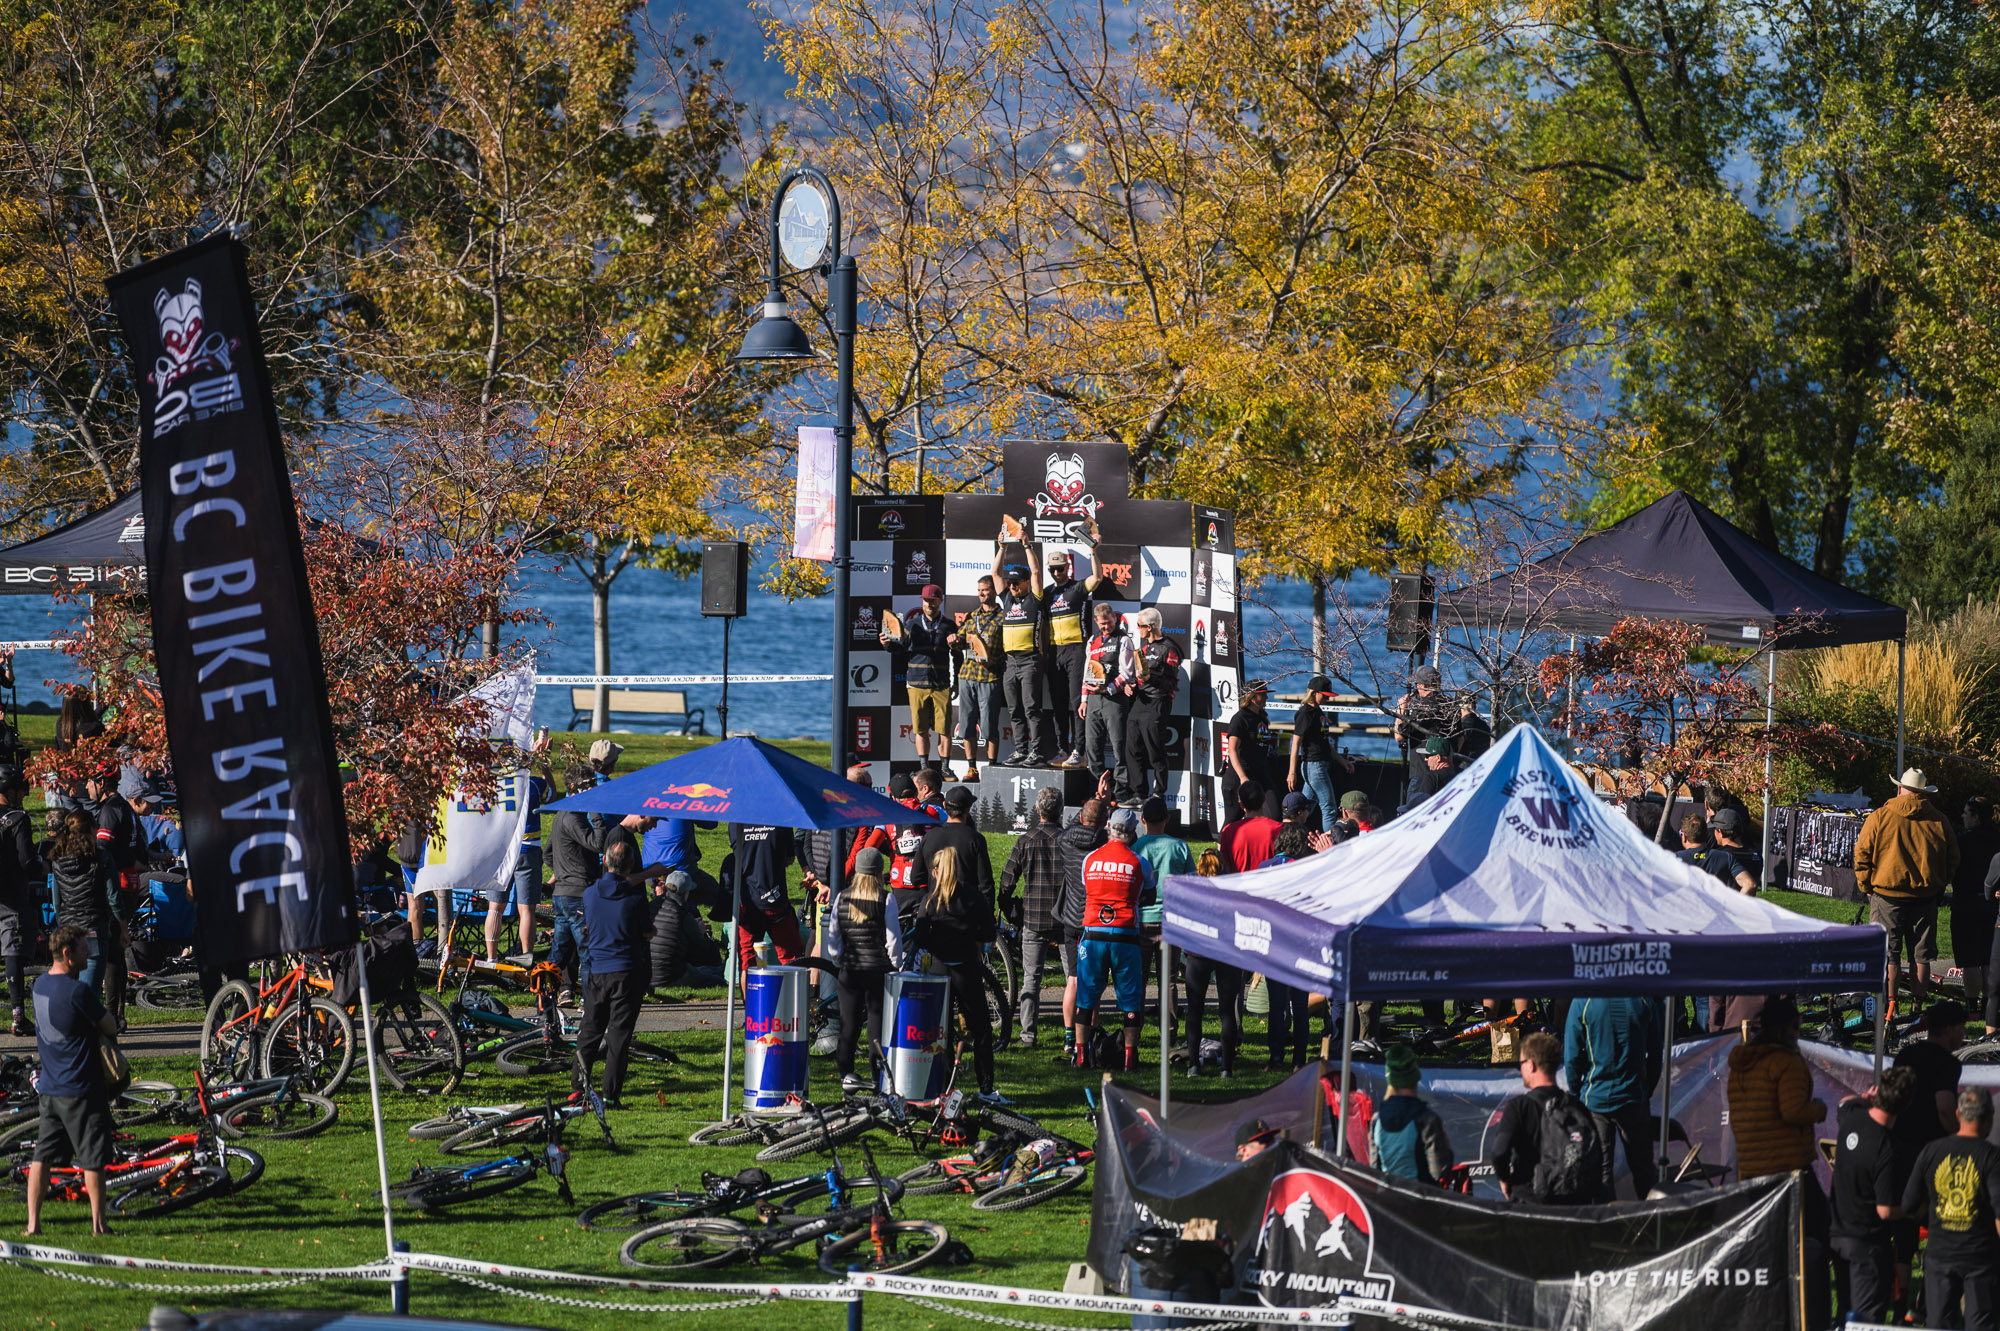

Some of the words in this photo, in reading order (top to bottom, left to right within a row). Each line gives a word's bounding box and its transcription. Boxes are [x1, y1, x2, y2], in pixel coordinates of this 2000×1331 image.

[949, 561, 992, 570] SHIMANO
[1101, 563, 1132, 584] FOX
[1144, 569, 1187, 578] SHIMANO
[4, 566, 57, 583] BC
[858, 719, 870, 749] CLIF
[1010, 775, 1037, 803] 1st
[1501, 770, 1580, 806] WHISTLER
[643, 797, 686, 811] Red
[687, 801, 731, 814] Bull
[1521, 796, 1570, 831] W
[744, 833, 768, 841] CREW
[1506, 814, 1588, 849] BREWING
[1571, 941, 1672, 963] WHISTLER
[1838, 961, 1867, 974] 1989
[1367, 970, 1431, 983] WHISTLER,
[1433, 970, 1450, 981] BC
[746, 1016, 769, 1033] Red
[771, 1017, 799, 1033] Bull
[906, 1024, 936, 1041] Red
[12, 1245, 50, 1260] ROCKY
[54, 1252, 117, 1267] MOUNTAIN
[145, 1262, 185, 1273] ROCKY
[188, 1265, 253, 1277] MOUNTAIN
[325, 1269, 391, 1280] MOUNTAIN
[416, 1258, 481, 1275] MOUNTAIN
[510, 1270, 551, 1282] ROCKY
[554, 1275, 620, 1288] MOUNTAIN
[1286, 1273, 1386, 1299] MOUNTAIN
[1574, 1270, 1638, 1288] LOVE
[1650, 1269, 1694, 1287] THE
[1705, 1268, 1769, 1286] RIDE
[693, 1286, 760, 1297] MOUNTAIN
[790, 1287, 831, 1298] ROCKY
[885, 1279, 928, 1292] ROCKY
[930, 1284, 998, 1300] MOUNTAIN
[1028, 1294, 1071, 1306] ROCKY
[1074, 1298, 1143, 1313] MOUNTAIN
[1173, 1306, 1216, 1318] ROCKY
[1220, 1309, 1290, 1321] MOUNTAIN
[1320, 1312, 1351, 1323] ROC
